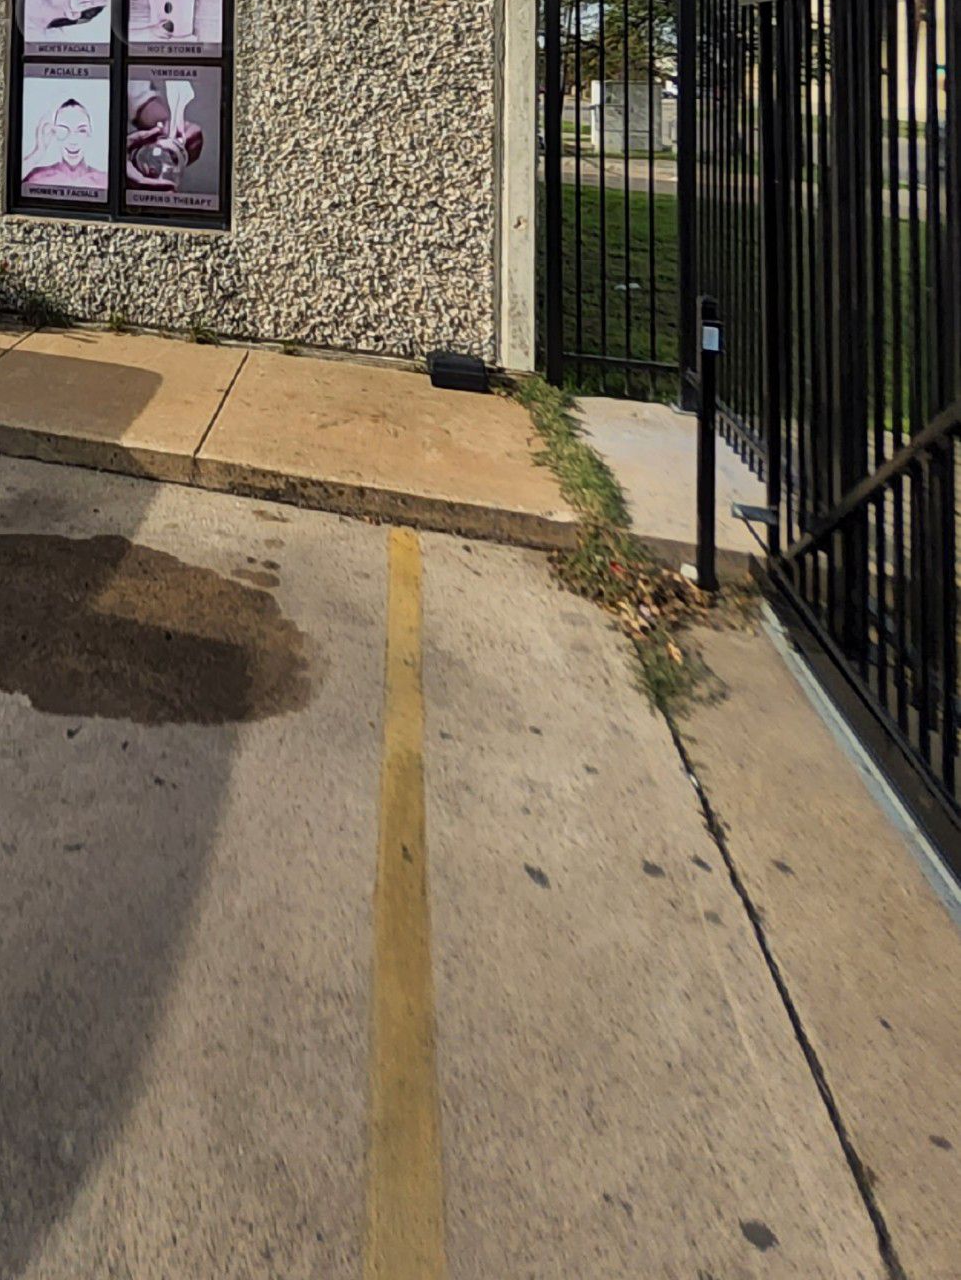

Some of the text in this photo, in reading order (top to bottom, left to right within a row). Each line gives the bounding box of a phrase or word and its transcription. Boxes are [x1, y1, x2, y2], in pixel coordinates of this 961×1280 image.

[147, 45, 202, 54] HOT STONES
[44, 67, 90, 77] FACIALES
[151, 68, 198, 77] VENTOSAS
